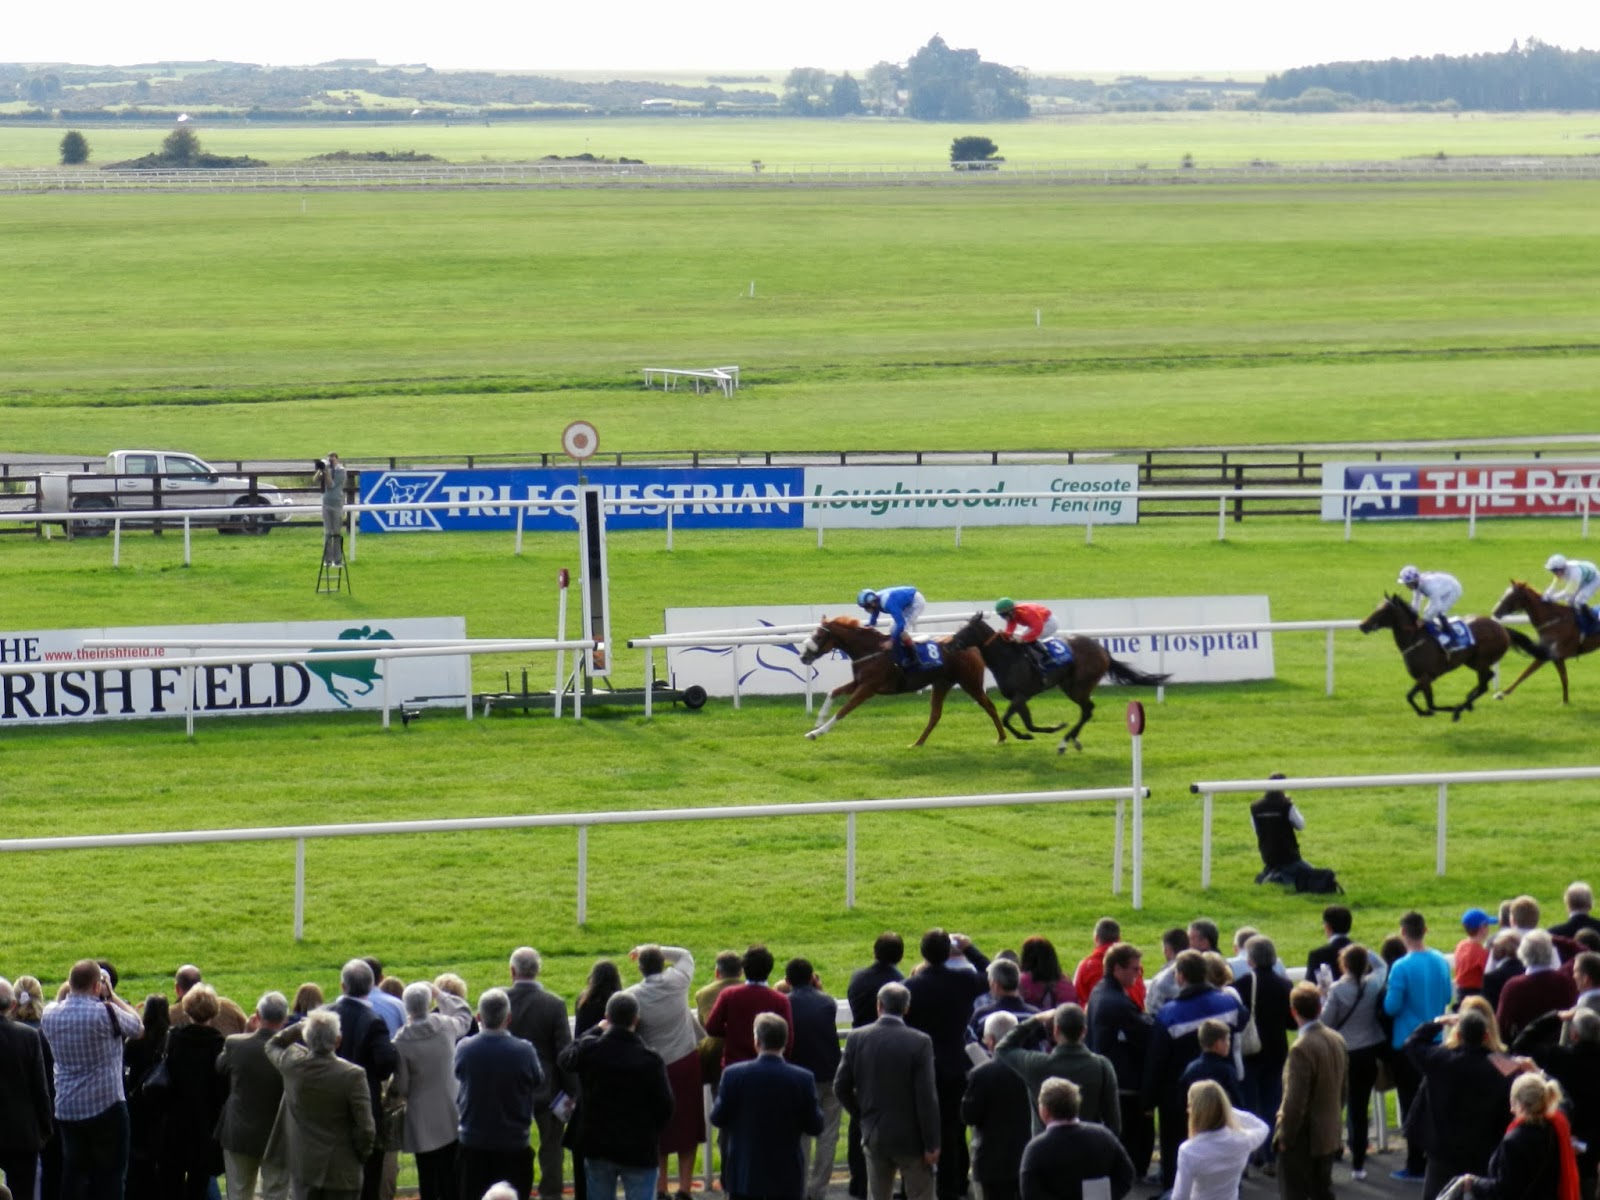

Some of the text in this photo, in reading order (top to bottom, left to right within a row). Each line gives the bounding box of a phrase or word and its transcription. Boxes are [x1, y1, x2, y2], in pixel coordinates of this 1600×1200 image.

[1050, 478, 1132, 493] Creosote
[1352, 472, 1411, 509] AT
[1426, 470, 1516, 508] THE
[441, 483, 791, 523] TRI EQESTRIAN
[1050, 496, 1122, 516] Fencing
[385, 509, 422, 526] TRI
[927, 643, 940, 660] 8
[1049, 640, 1066, 654] 3
[1150, 630, 1259, 657] Hospital
